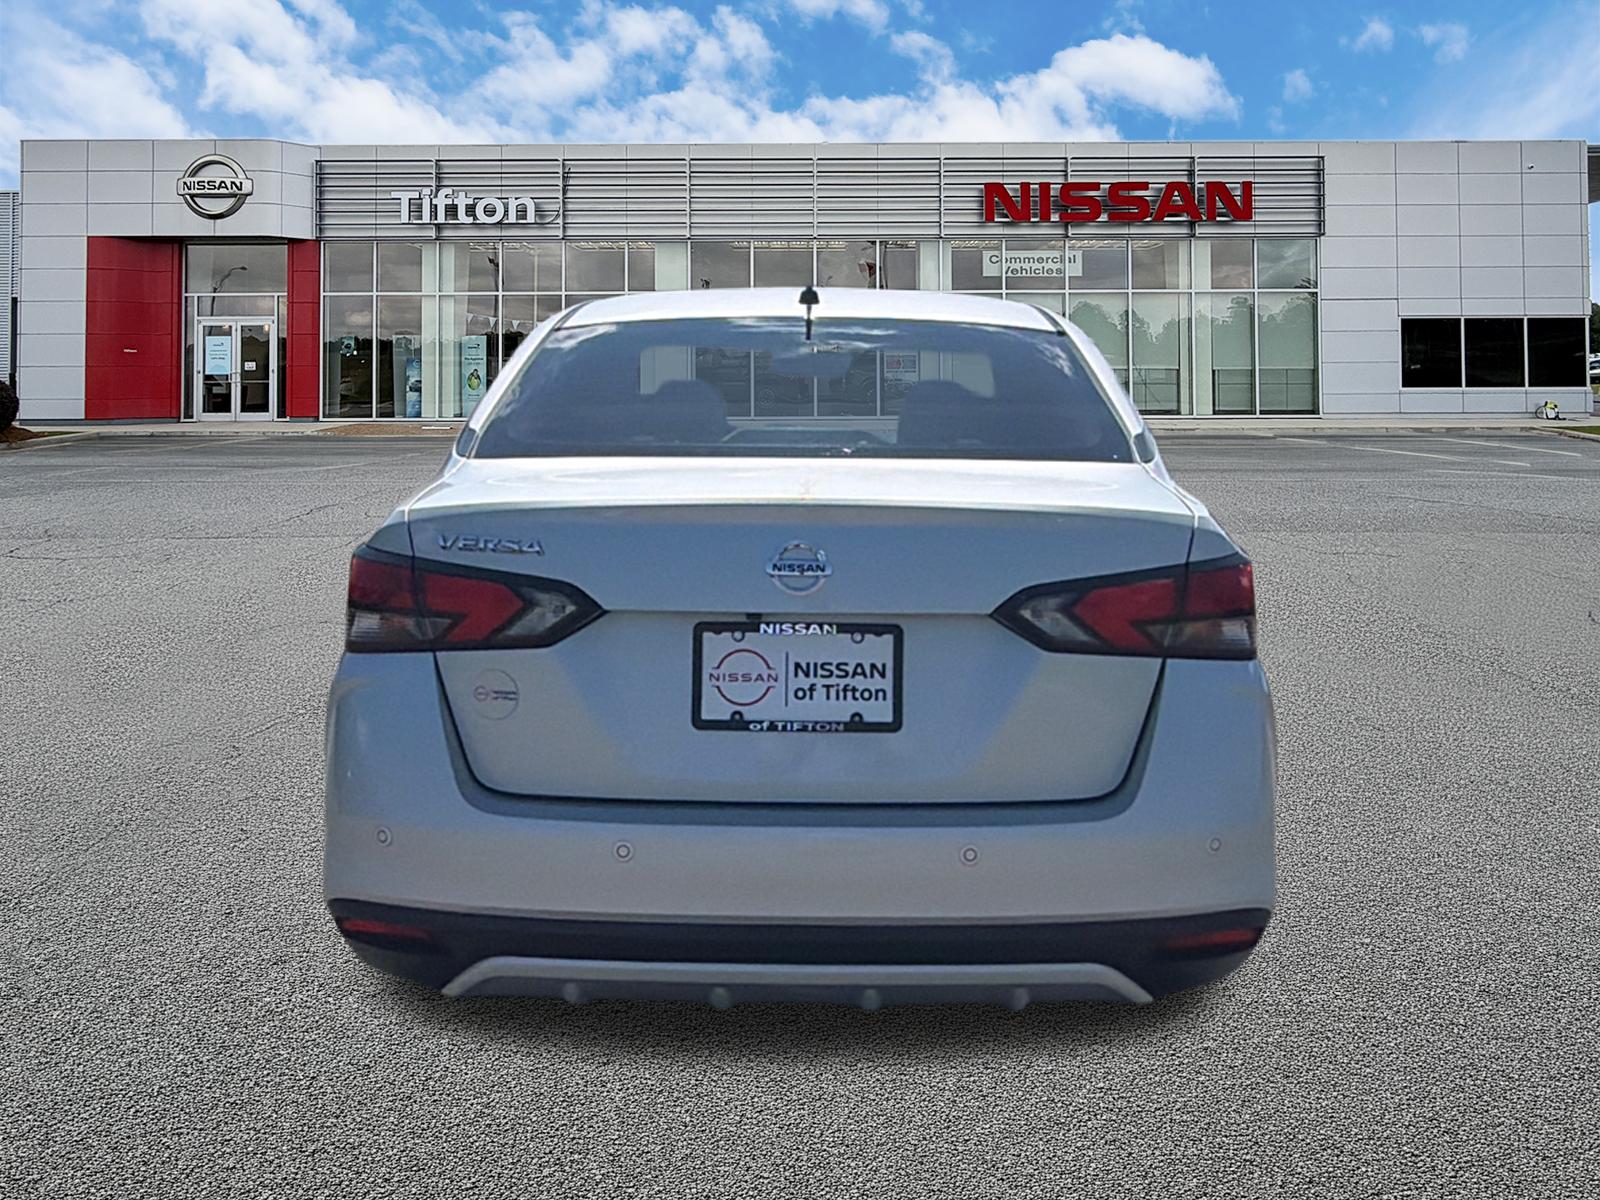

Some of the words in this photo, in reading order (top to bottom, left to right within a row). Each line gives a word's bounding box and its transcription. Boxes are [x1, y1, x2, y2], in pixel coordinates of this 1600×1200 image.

[182, 180, 243, 192] NISSAN
[390, 187, 537, 225] Tifton
[983, 180, 1254, 223] NISSAN
[988, 254, 1077, 265] Cmmercil
[437, 533, 545, 557] VERSA
[771, 562, 826, 573] NISSAN
[759, 622, 838, 636] NISSAN
[708, 671, 779, 683] NISSAN
[793, 661, 888, 680] NISSAN
[793, 683, 817, 702] of
[821, 683, 888, 703] Tifton
[748, 720, 770, 732] of
[773, 720, 846, 733] TIFTON
